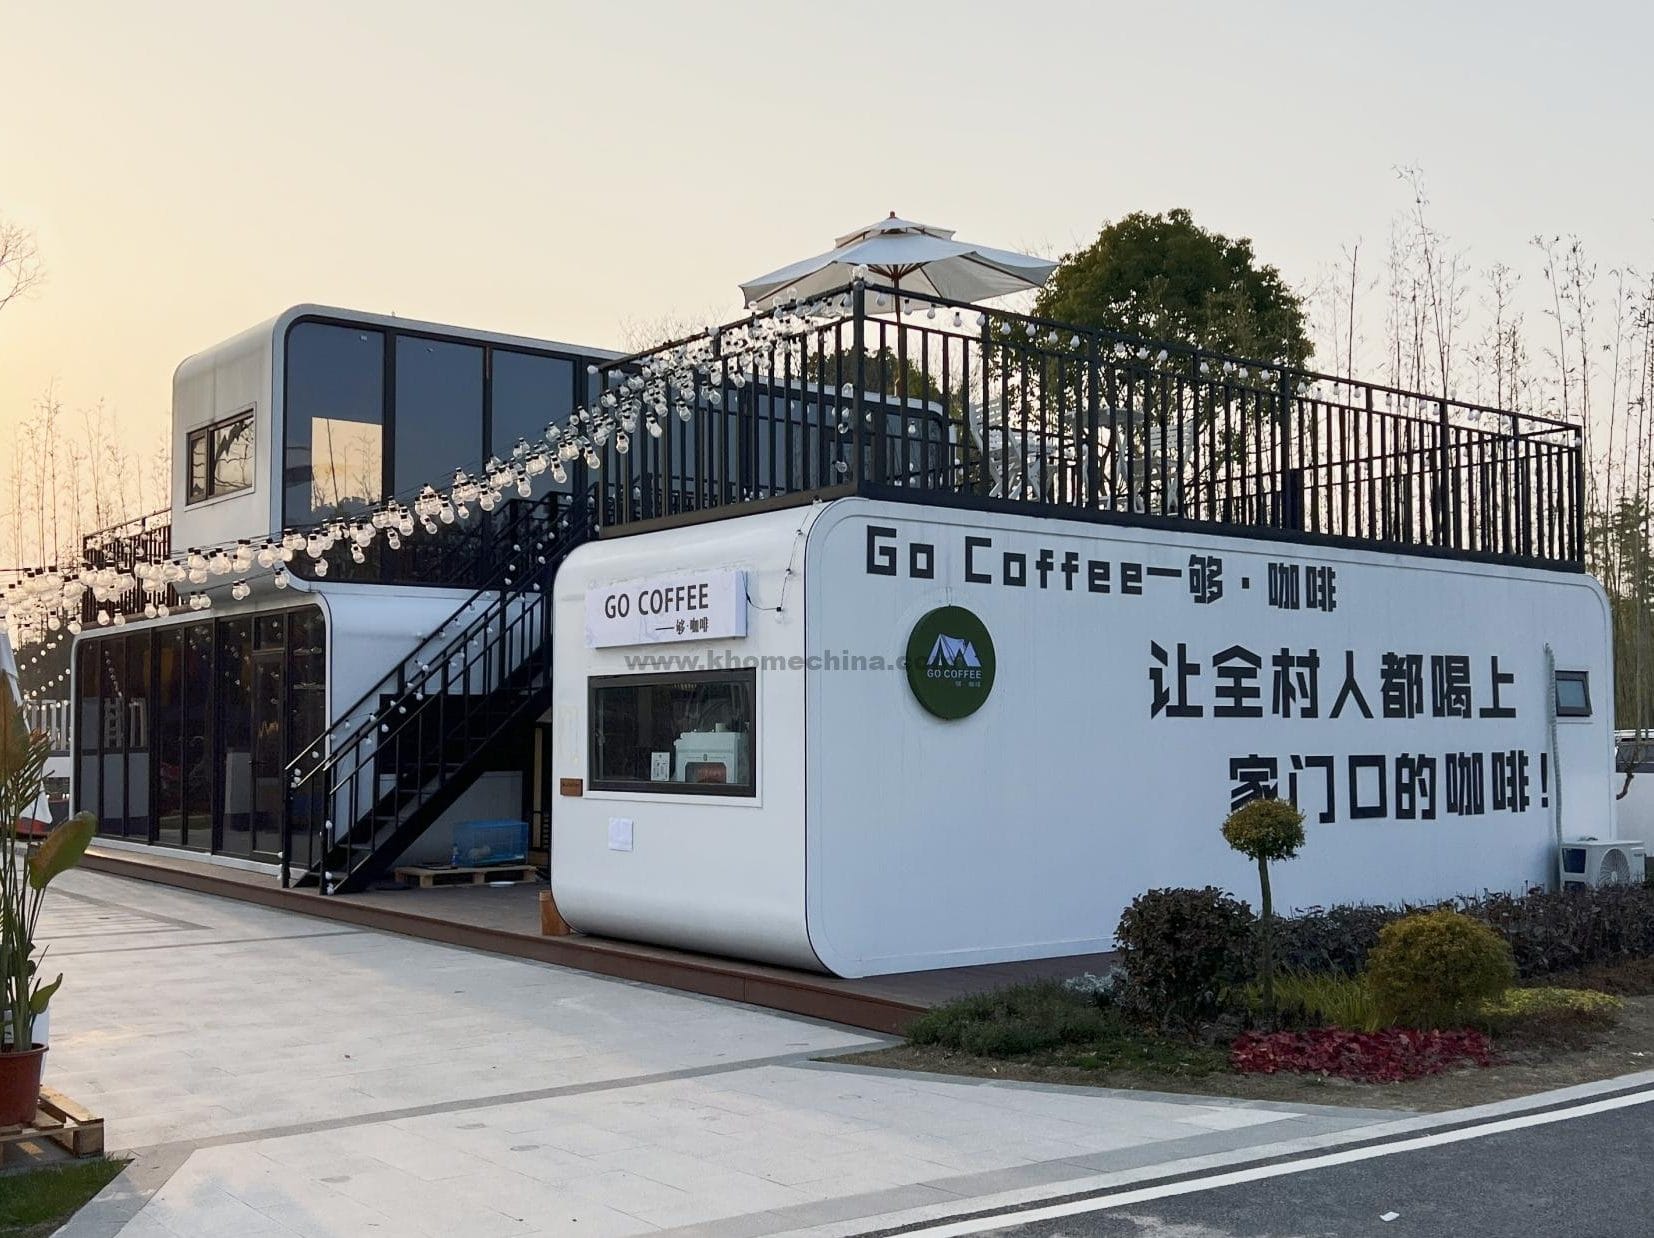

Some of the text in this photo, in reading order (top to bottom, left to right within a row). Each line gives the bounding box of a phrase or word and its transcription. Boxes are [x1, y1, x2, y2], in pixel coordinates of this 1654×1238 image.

[866, 525, 935, 580] Go
[604, 583, 709, 619] GO COFFEE
[926, 669, 982, 679] GO COFFEE
[1149, 639, 1517, 720] 让全村人都喝上
